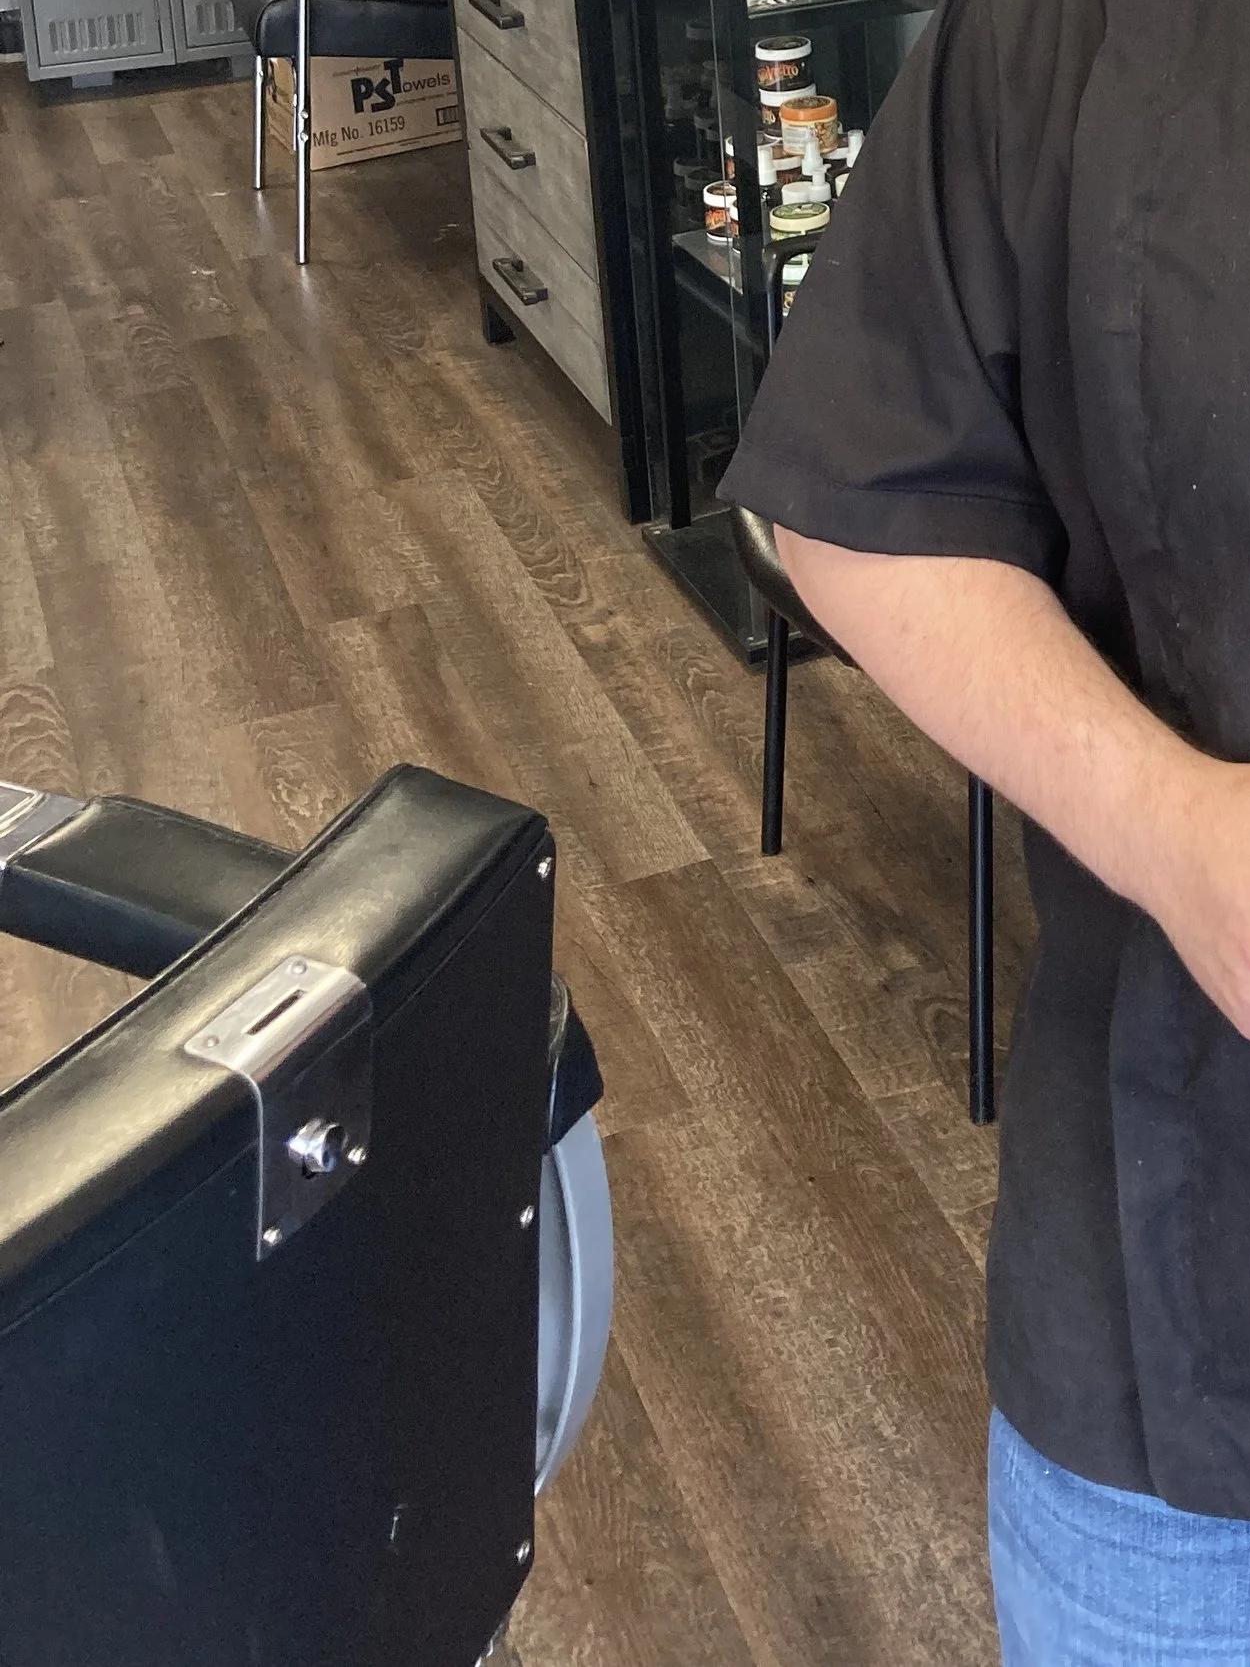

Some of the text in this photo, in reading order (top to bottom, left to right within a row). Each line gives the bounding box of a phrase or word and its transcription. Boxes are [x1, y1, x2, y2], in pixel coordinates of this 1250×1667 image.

[312, 115, 405, 147] Mfg No. 16159
